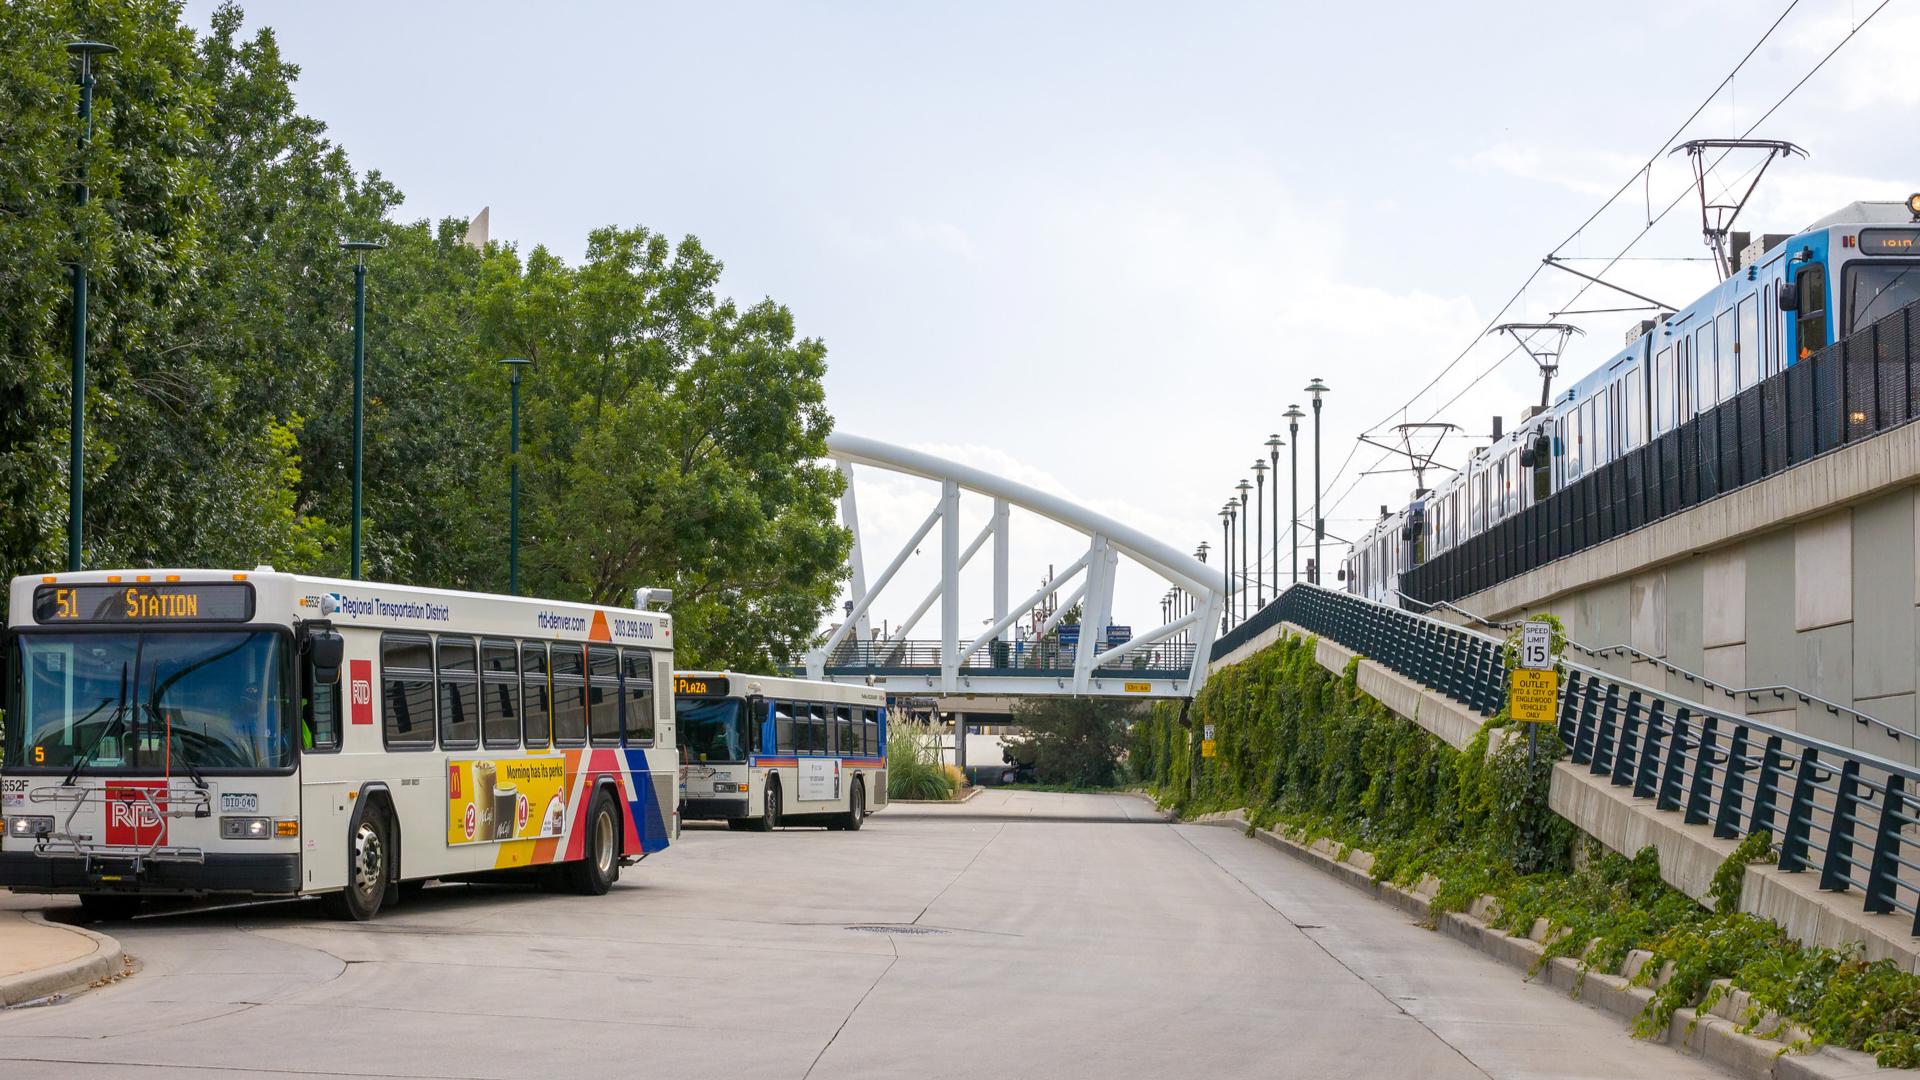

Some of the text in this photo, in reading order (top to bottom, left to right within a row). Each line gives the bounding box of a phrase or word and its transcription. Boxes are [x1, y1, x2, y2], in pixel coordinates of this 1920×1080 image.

[56, 589, 79, 618] 51
[342, 596, 449, 621] Regional Transportation District
[538, 611, 586, 631] rtd-denver.com
[614, 619, 654, 639] 303.299.6000
[1526, 646, 1545, 662] 15
[1519, 680, 1550, 689] OUTLET
[1529, 672, 1541, 680] NO
[353, 680, 371, 704] RTD
[1516, 696, 1552, 704] ENGLEWOOD
[1520, 703, 1548, 711] VEHICLES
[1525, 711, 1541, 719] ONLY
[35, 746, 45, 762] 5
[506, 762, 563, 783] Morning has its perks
[112, 802, 162, 827] RTD
